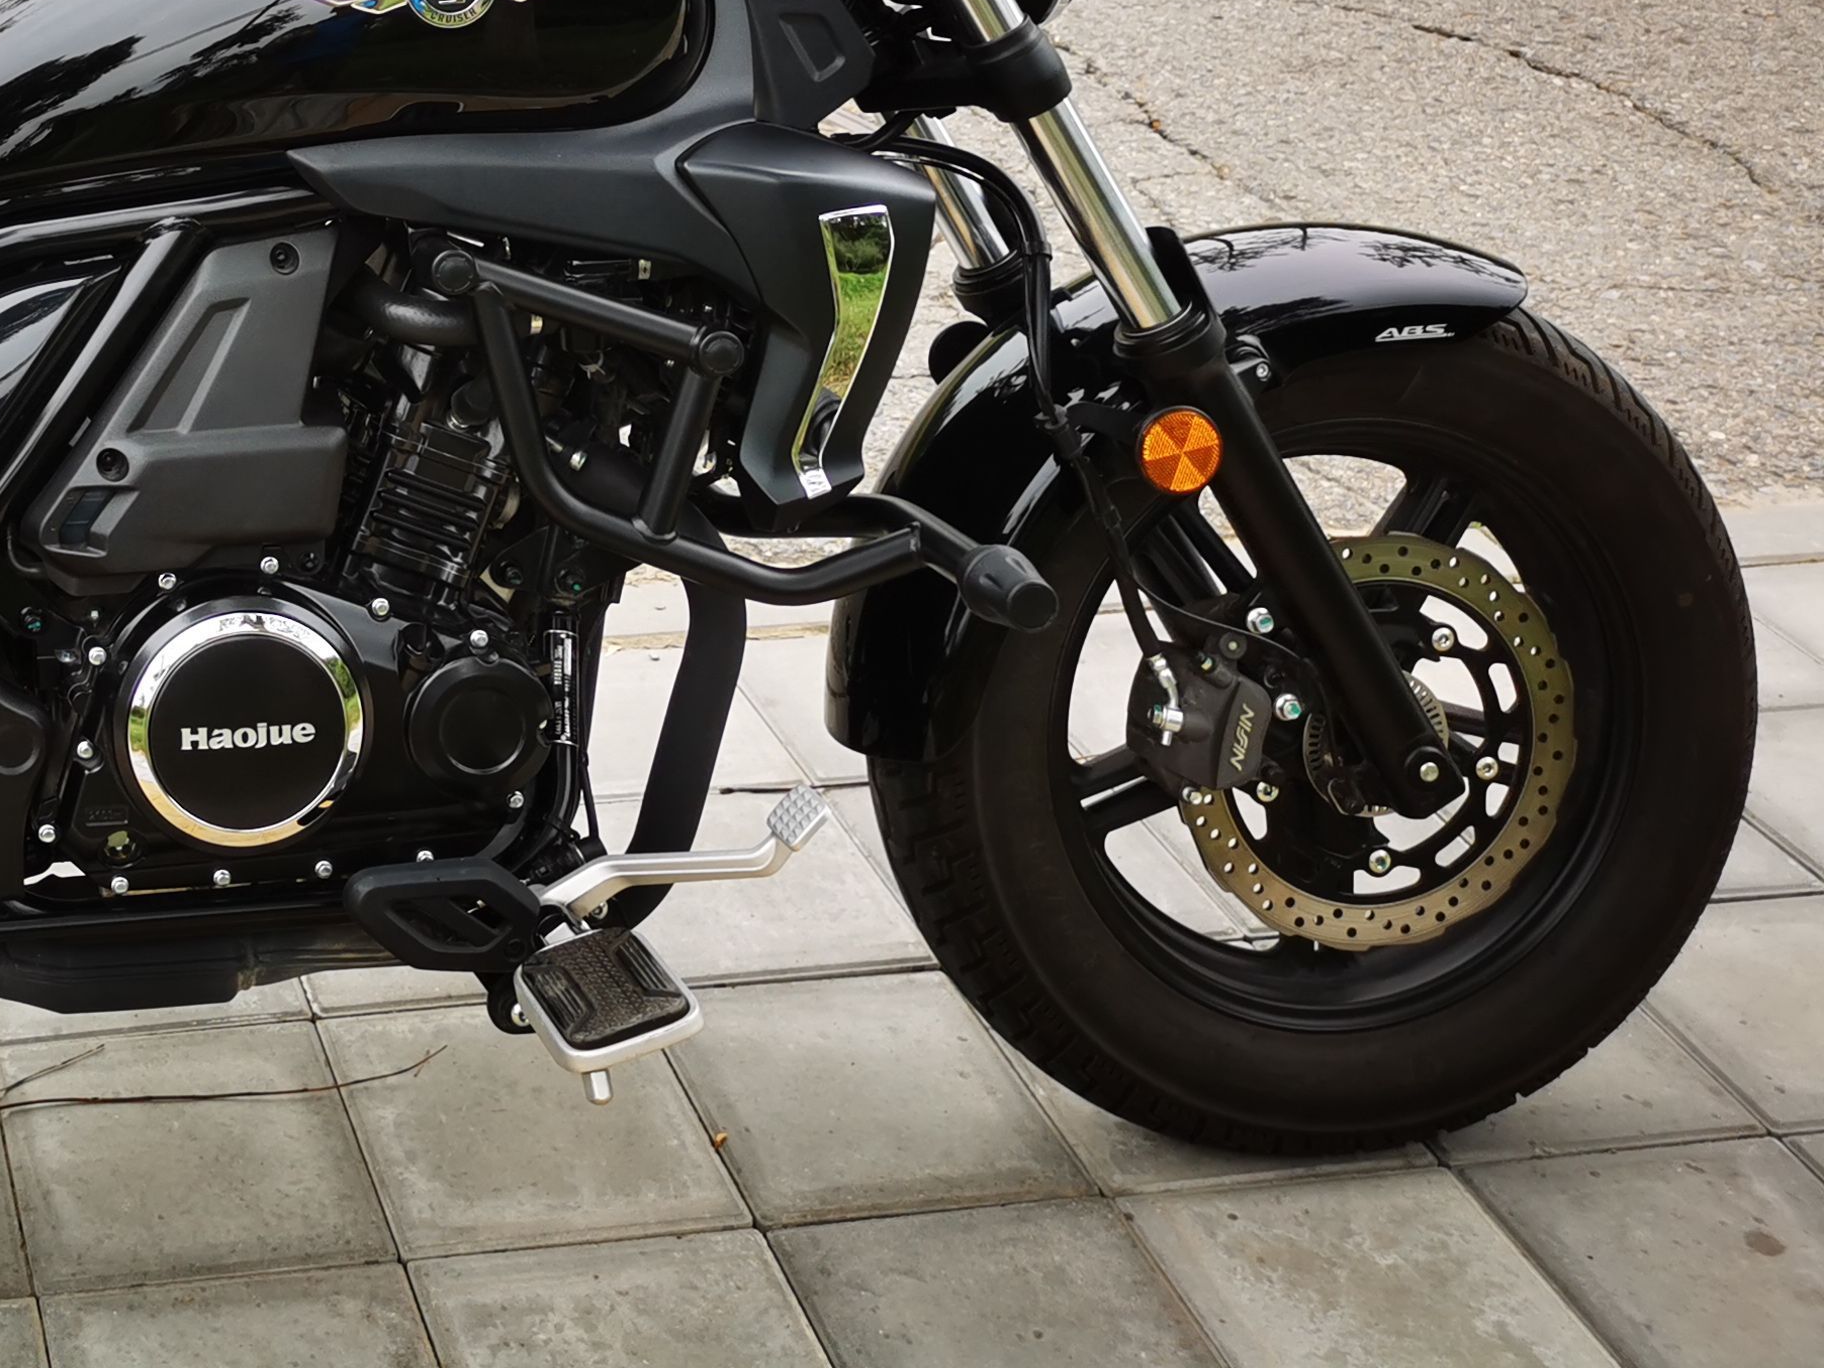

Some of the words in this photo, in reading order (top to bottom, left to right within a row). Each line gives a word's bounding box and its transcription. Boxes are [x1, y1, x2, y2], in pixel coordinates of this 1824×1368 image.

[429, 7, 478, 24] CRUISER
[1375, 323, 1448, 342] ABS
[180, 722, 316, 751] Haojue
